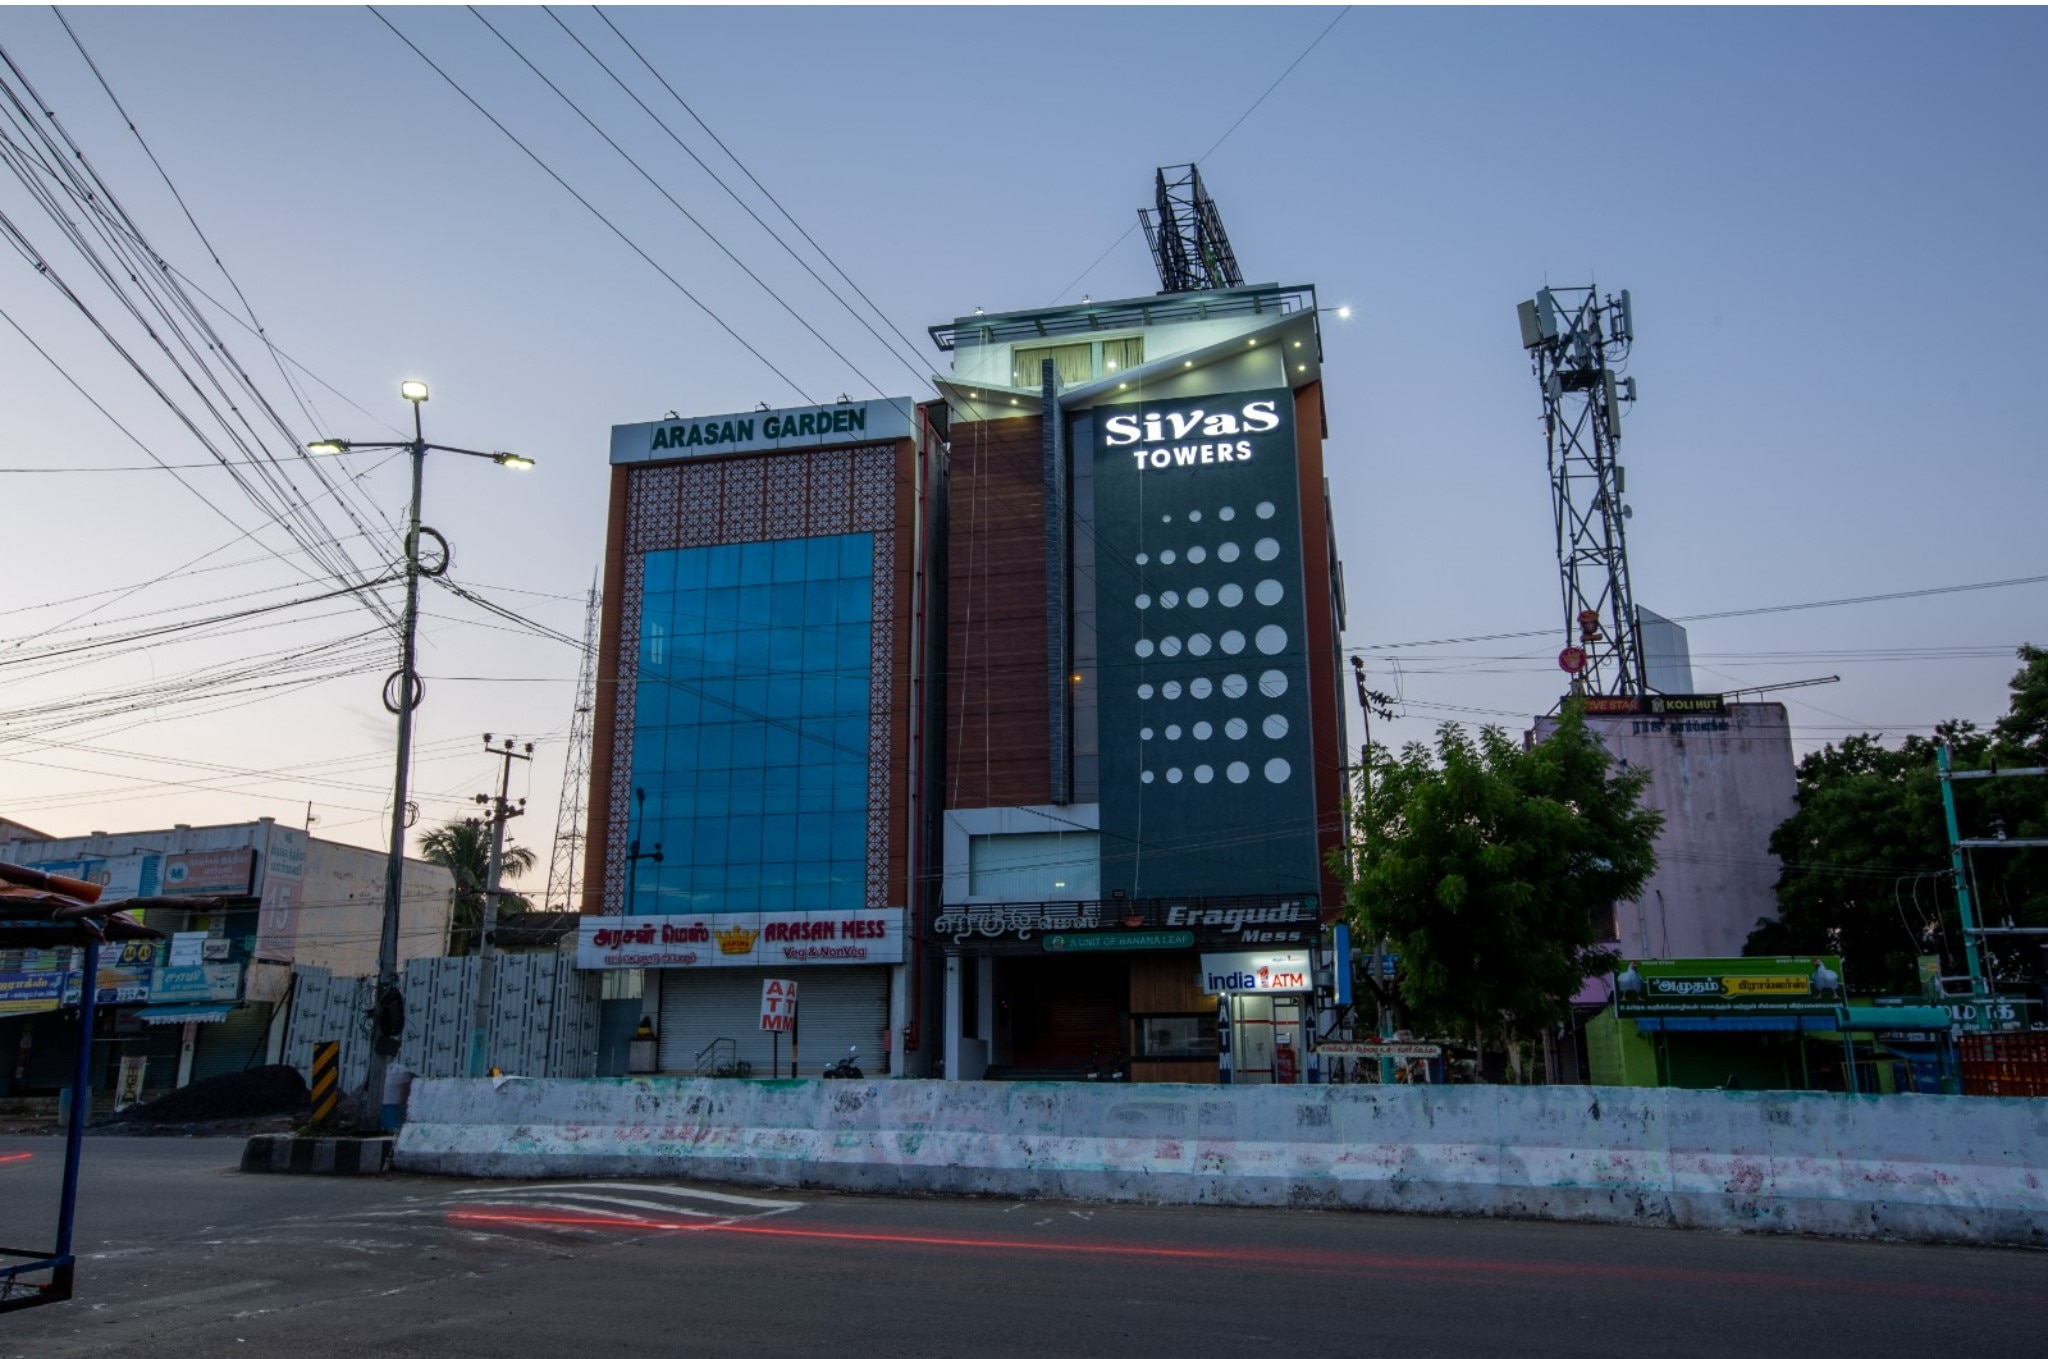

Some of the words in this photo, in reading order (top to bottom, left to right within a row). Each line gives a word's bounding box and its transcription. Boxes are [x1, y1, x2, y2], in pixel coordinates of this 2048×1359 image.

[652, 418, 754, 450] ARASAN
[763, 408, 865, 440] GARDEN
[1106, 401, 1280, 446] SivaS
[1133, 441, 1252, 470] TOWERS
[1666, 700, 1694, 710] KOLI
[1697, 700, 1718, 709] HUT
[1166, 903, 1300, 934] Eragudi
[593, 923, 656, 950] அரசன்
[765, 921, 835, 942] ARASAN
[842, 920, 886, 939] MESS
[1069, 938, 1077, 947] A
[1104, 937, 1117, 946] OF
[1119, 936, 1160, 946] BANANA
[1163, 935, 1187, 944] LEAF
[1241, 929, 1301, 943] Mess
[784, 947, 805, 958] Veg
[808, 947, 816, 957] &
[1208, 972, 1255, 990] india
[1272, 973, 1304, 988] ATM
[1657, 976, 1720, 994] அமுதம்
[761, 980, 784, 1030] ATM
[1219, 1005, 1231, 1069] ATM
